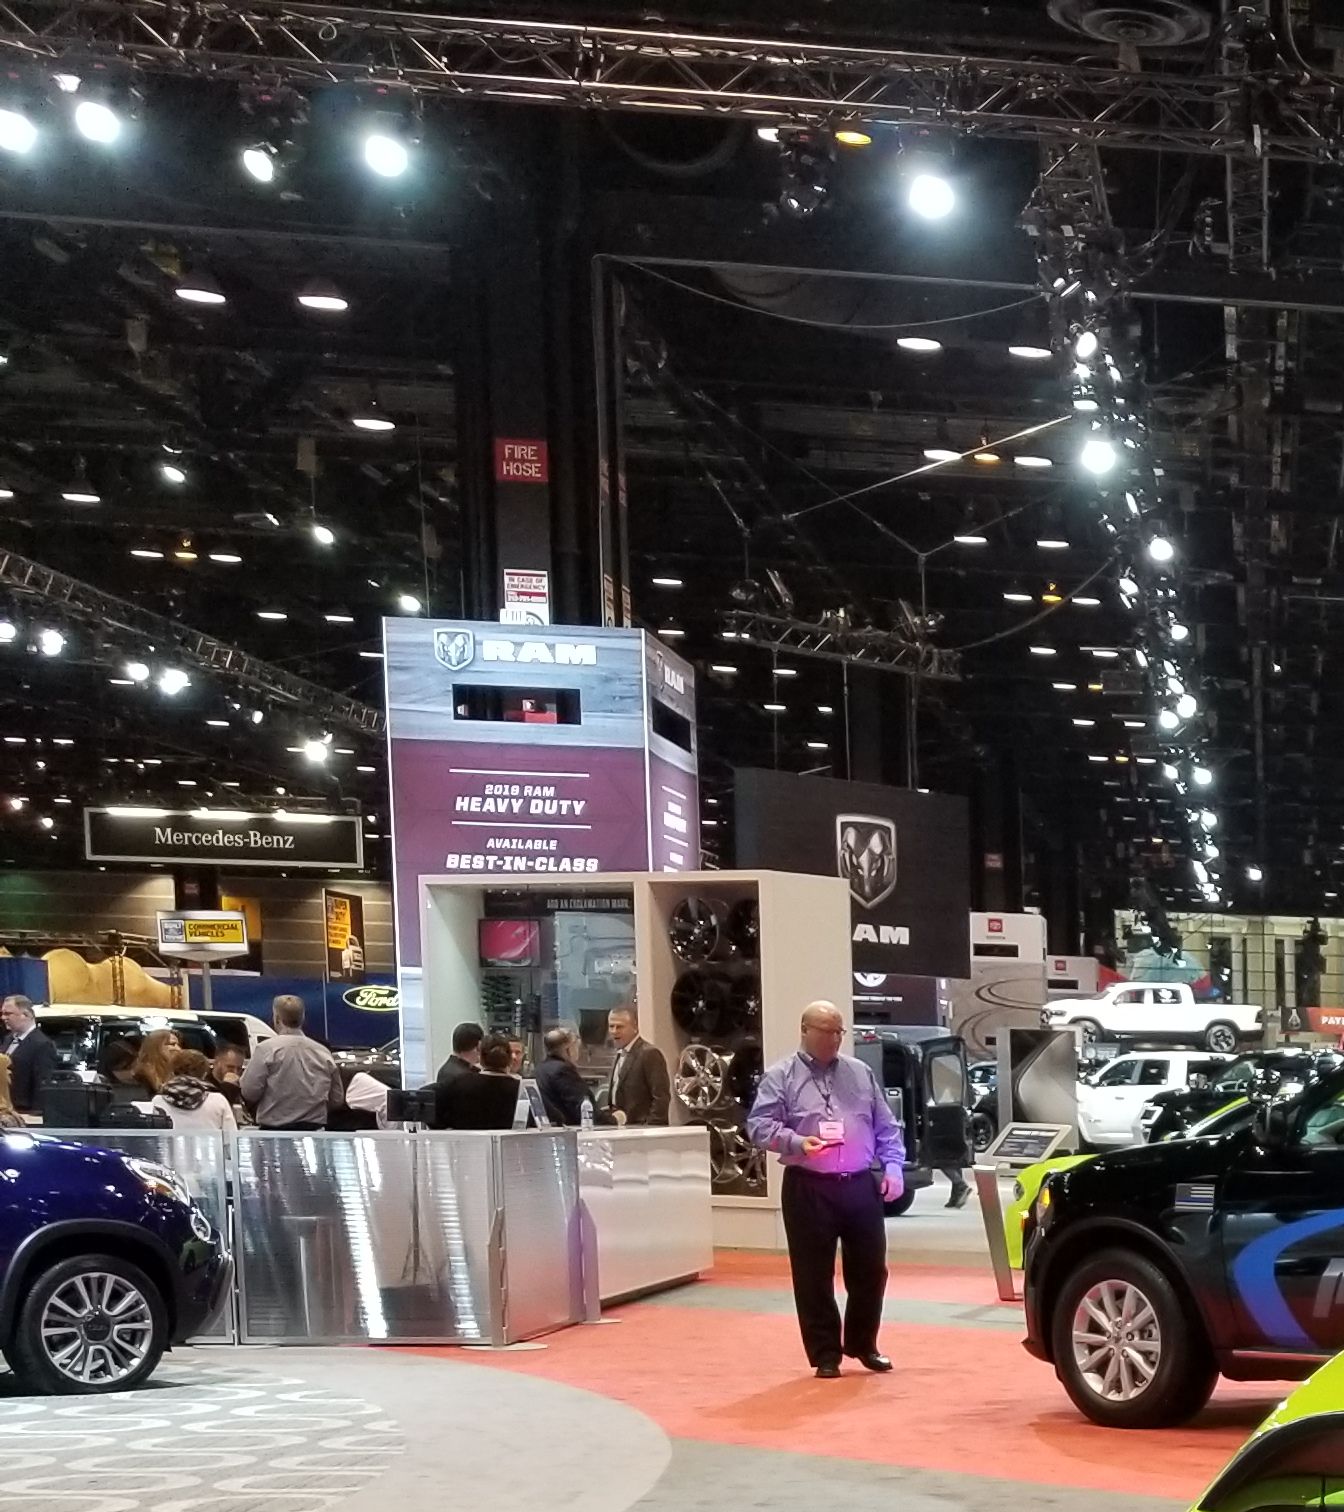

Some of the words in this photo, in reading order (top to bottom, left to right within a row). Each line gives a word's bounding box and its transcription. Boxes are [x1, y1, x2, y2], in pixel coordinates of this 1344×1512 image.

[504, 444, 538, 460] FIRE
[502, 462, 542, 477] HOSE
[482, 640, 597, 665] RAM
[523, 785, 556, 797] RAM
[455, 796, 524, 814] HEAVY
[529, 799, 586, 816] DUTY
[154, 827, 295, 849] Mercedes-Benz
[486, 838, 558, 850] AVAILABLE
[445, 853, 599, 872] BEST-IN-CLASS
[852, 923, 910, 946] AM
[355, 988, 398, 1006] Ford
